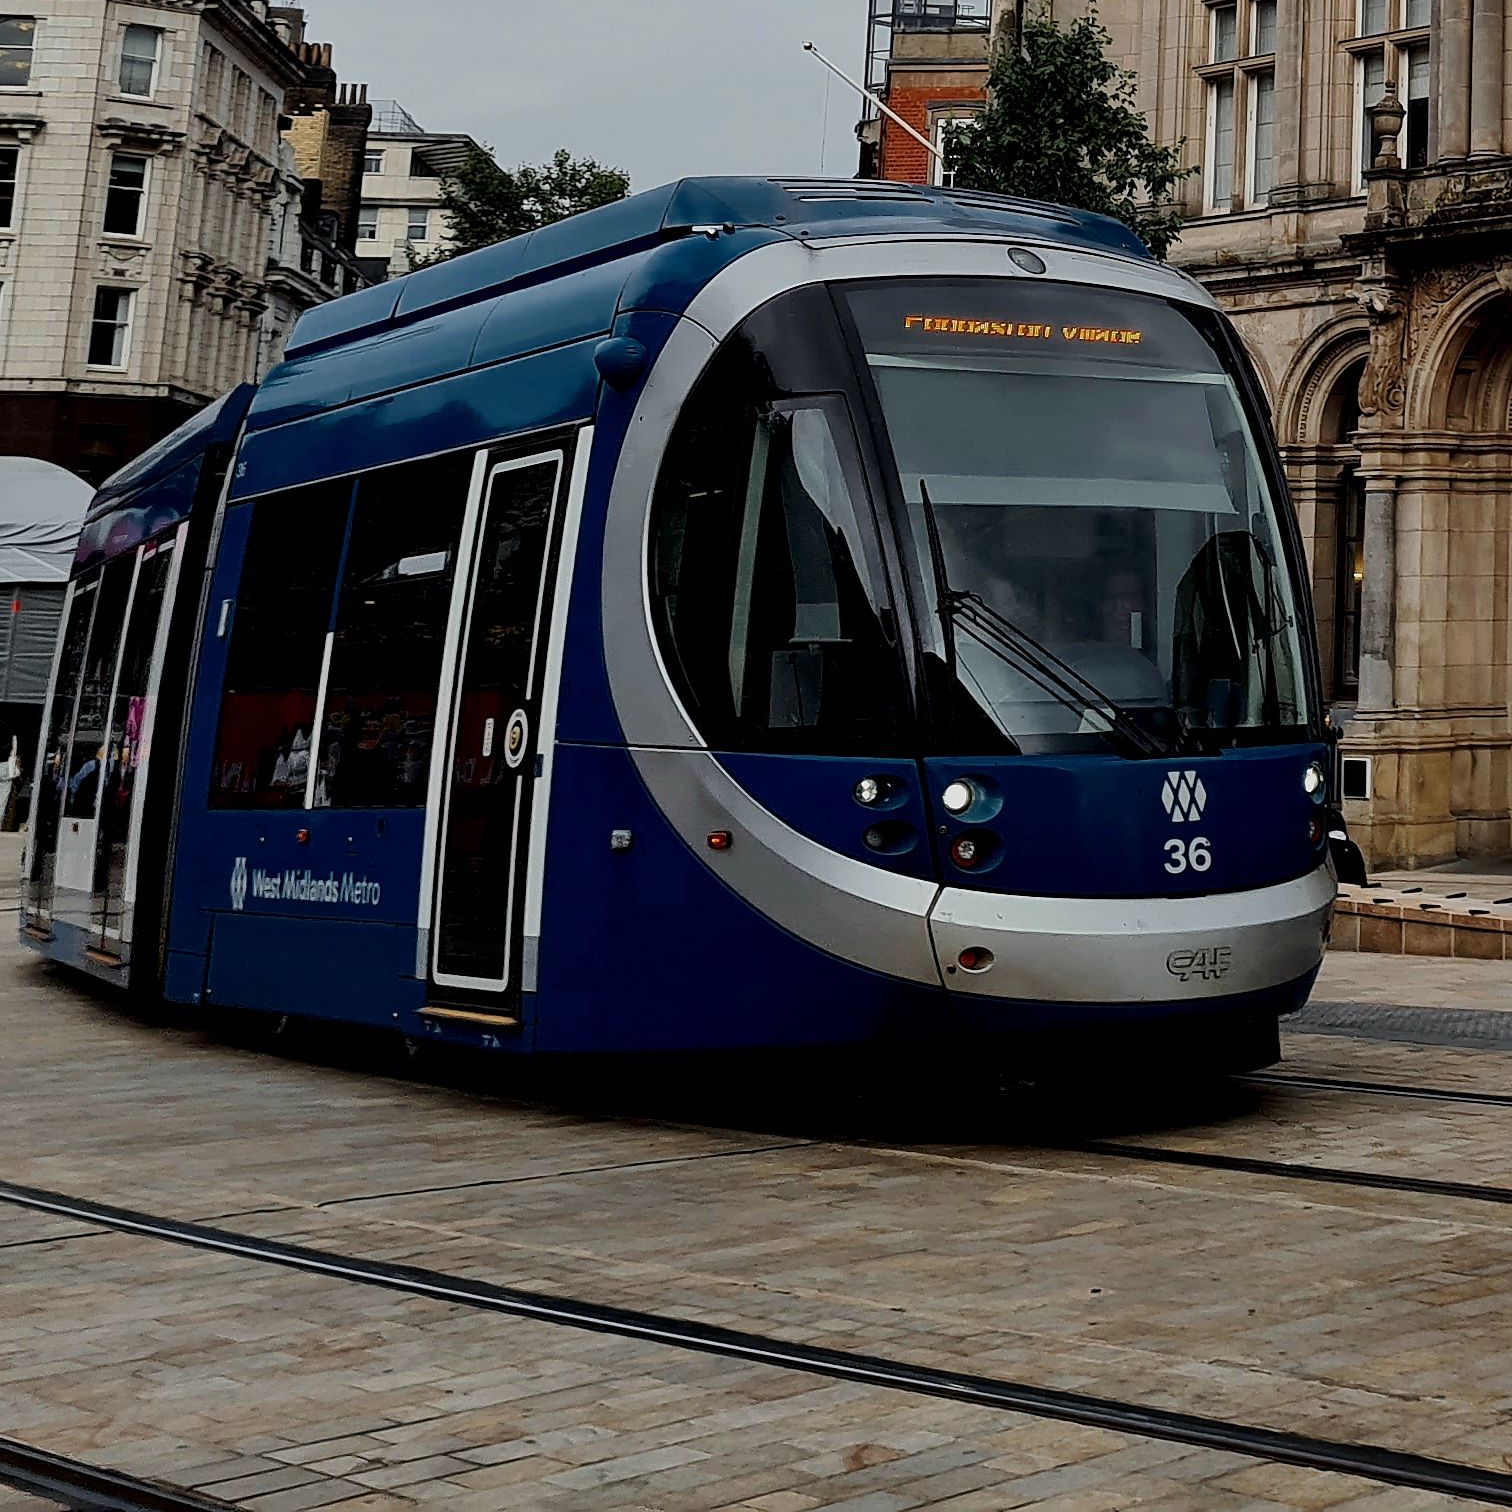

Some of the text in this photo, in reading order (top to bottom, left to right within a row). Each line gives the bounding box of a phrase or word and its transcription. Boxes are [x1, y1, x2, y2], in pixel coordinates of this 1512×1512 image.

[1164, 837, 1211, 874] 36
[253, 869, 380, 905] West Midlands Metro
